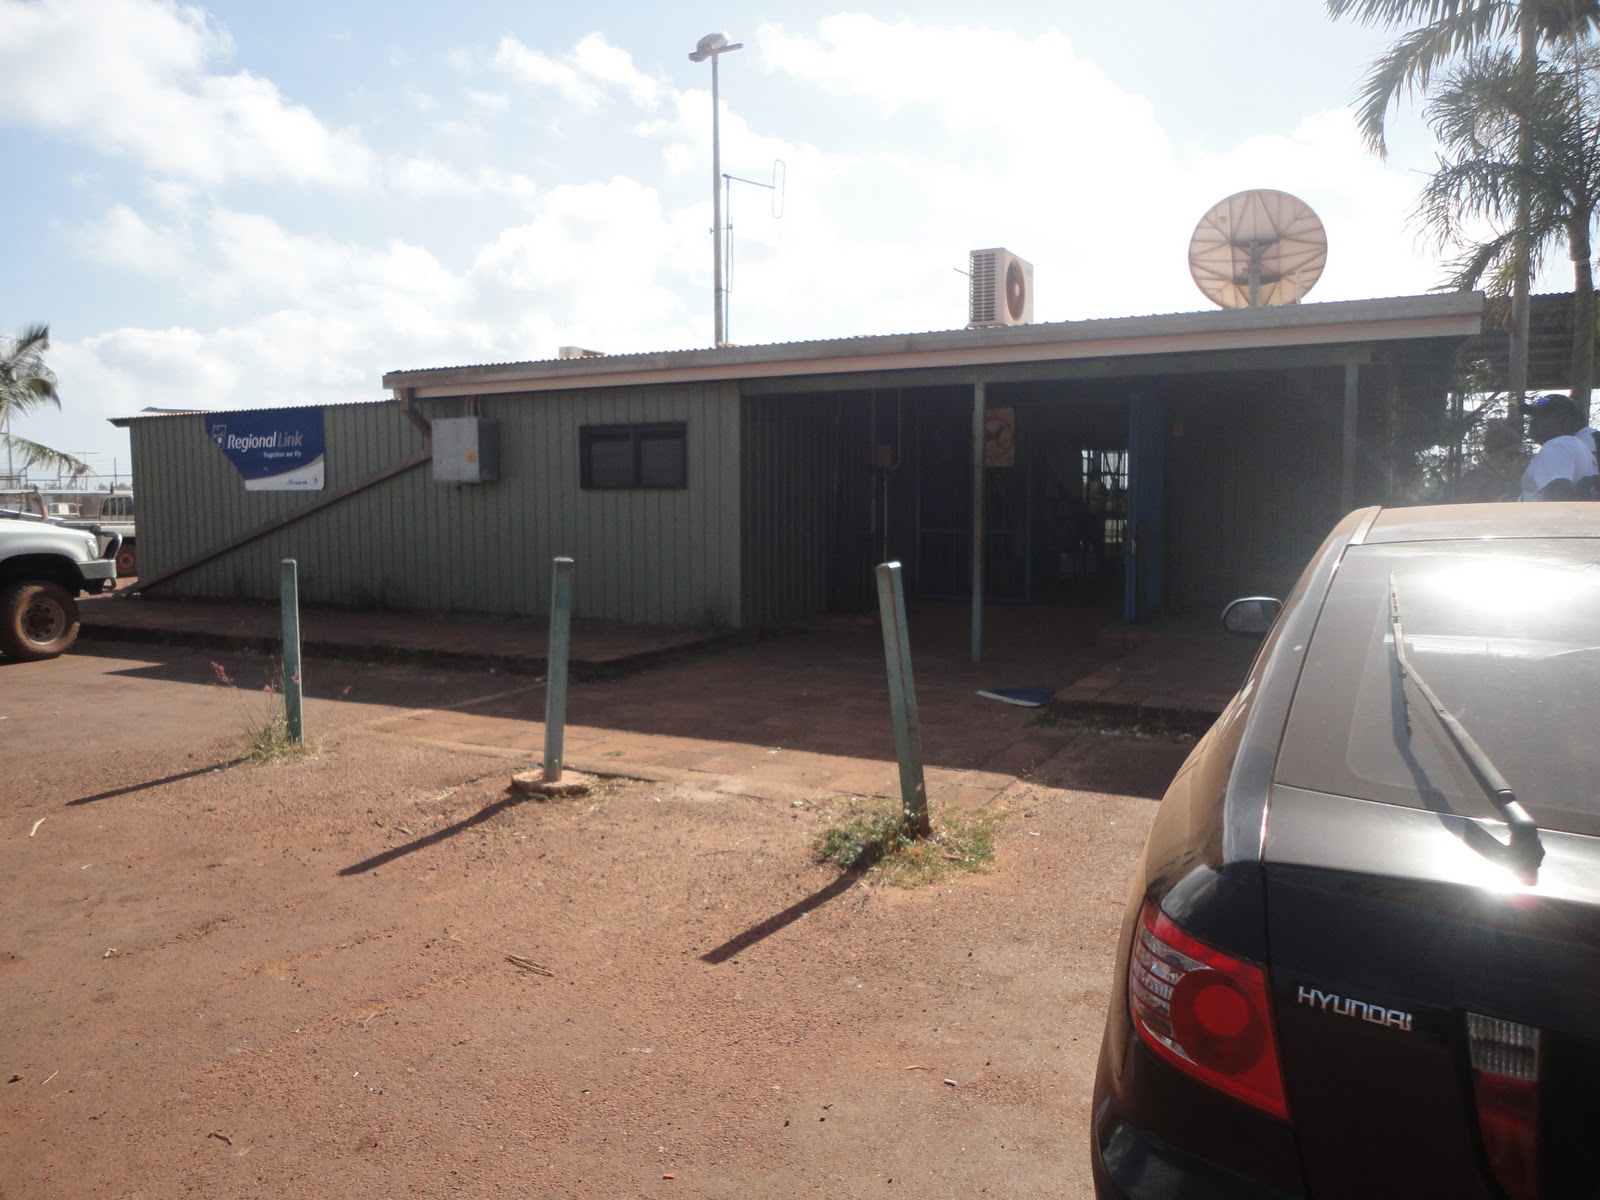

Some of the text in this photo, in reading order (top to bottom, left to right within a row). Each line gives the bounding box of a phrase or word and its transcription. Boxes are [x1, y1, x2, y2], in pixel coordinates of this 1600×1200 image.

[227, 430, 303, 452] Regional Link
[263, 452, 285, 460] Together
[1297, 985, 1413, 1031] HYUNDAI
